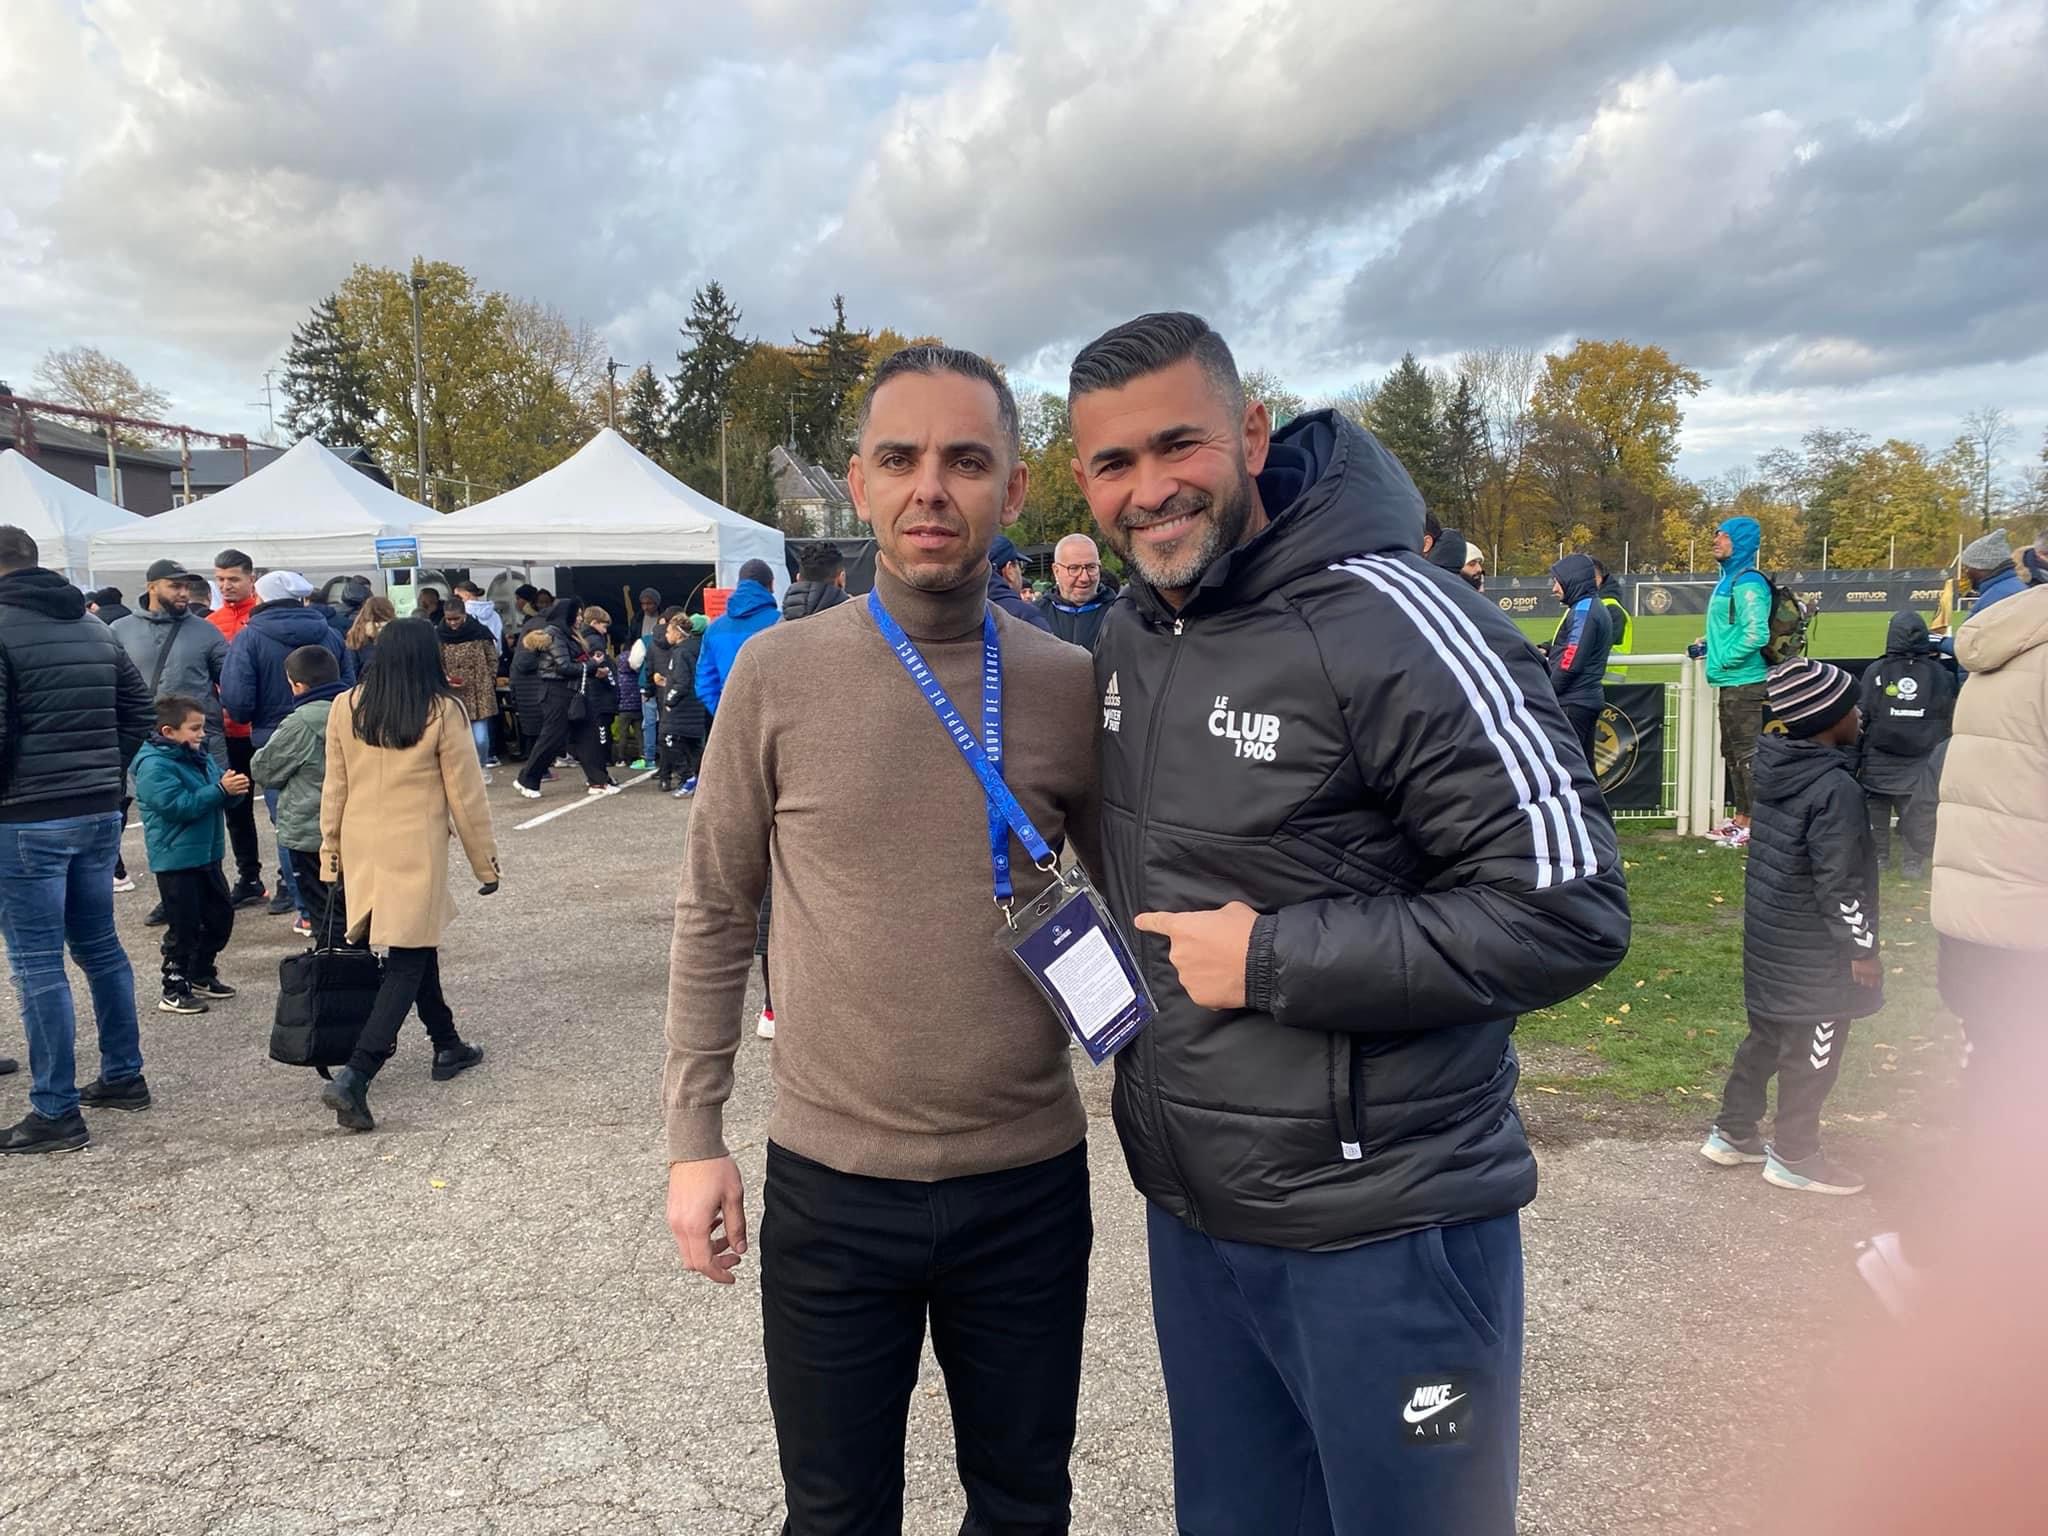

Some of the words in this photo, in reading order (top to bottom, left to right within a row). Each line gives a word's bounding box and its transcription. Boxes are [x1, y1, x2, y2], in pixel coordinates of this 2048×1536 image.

[1513, 596, 1538, 606] sport
[896, 641, 933, 686] FRANCE
[986, 644, 998, 690] FRANCE
[930, 690, 946, 706] DE
[986, 699, 998, 713] DE
[1214, 695, 1229, 709] LE
[943, 711, 974, 750] COUPE
[1208, 709, 1280, 743] CLUB
[986, 722, 999, 761] COUPE
[1234, 739, 1277, 762] 1906
[1412, 1384, 1452, 1407] NIKE
[1416, 1422, 1457, 1436] AIR
